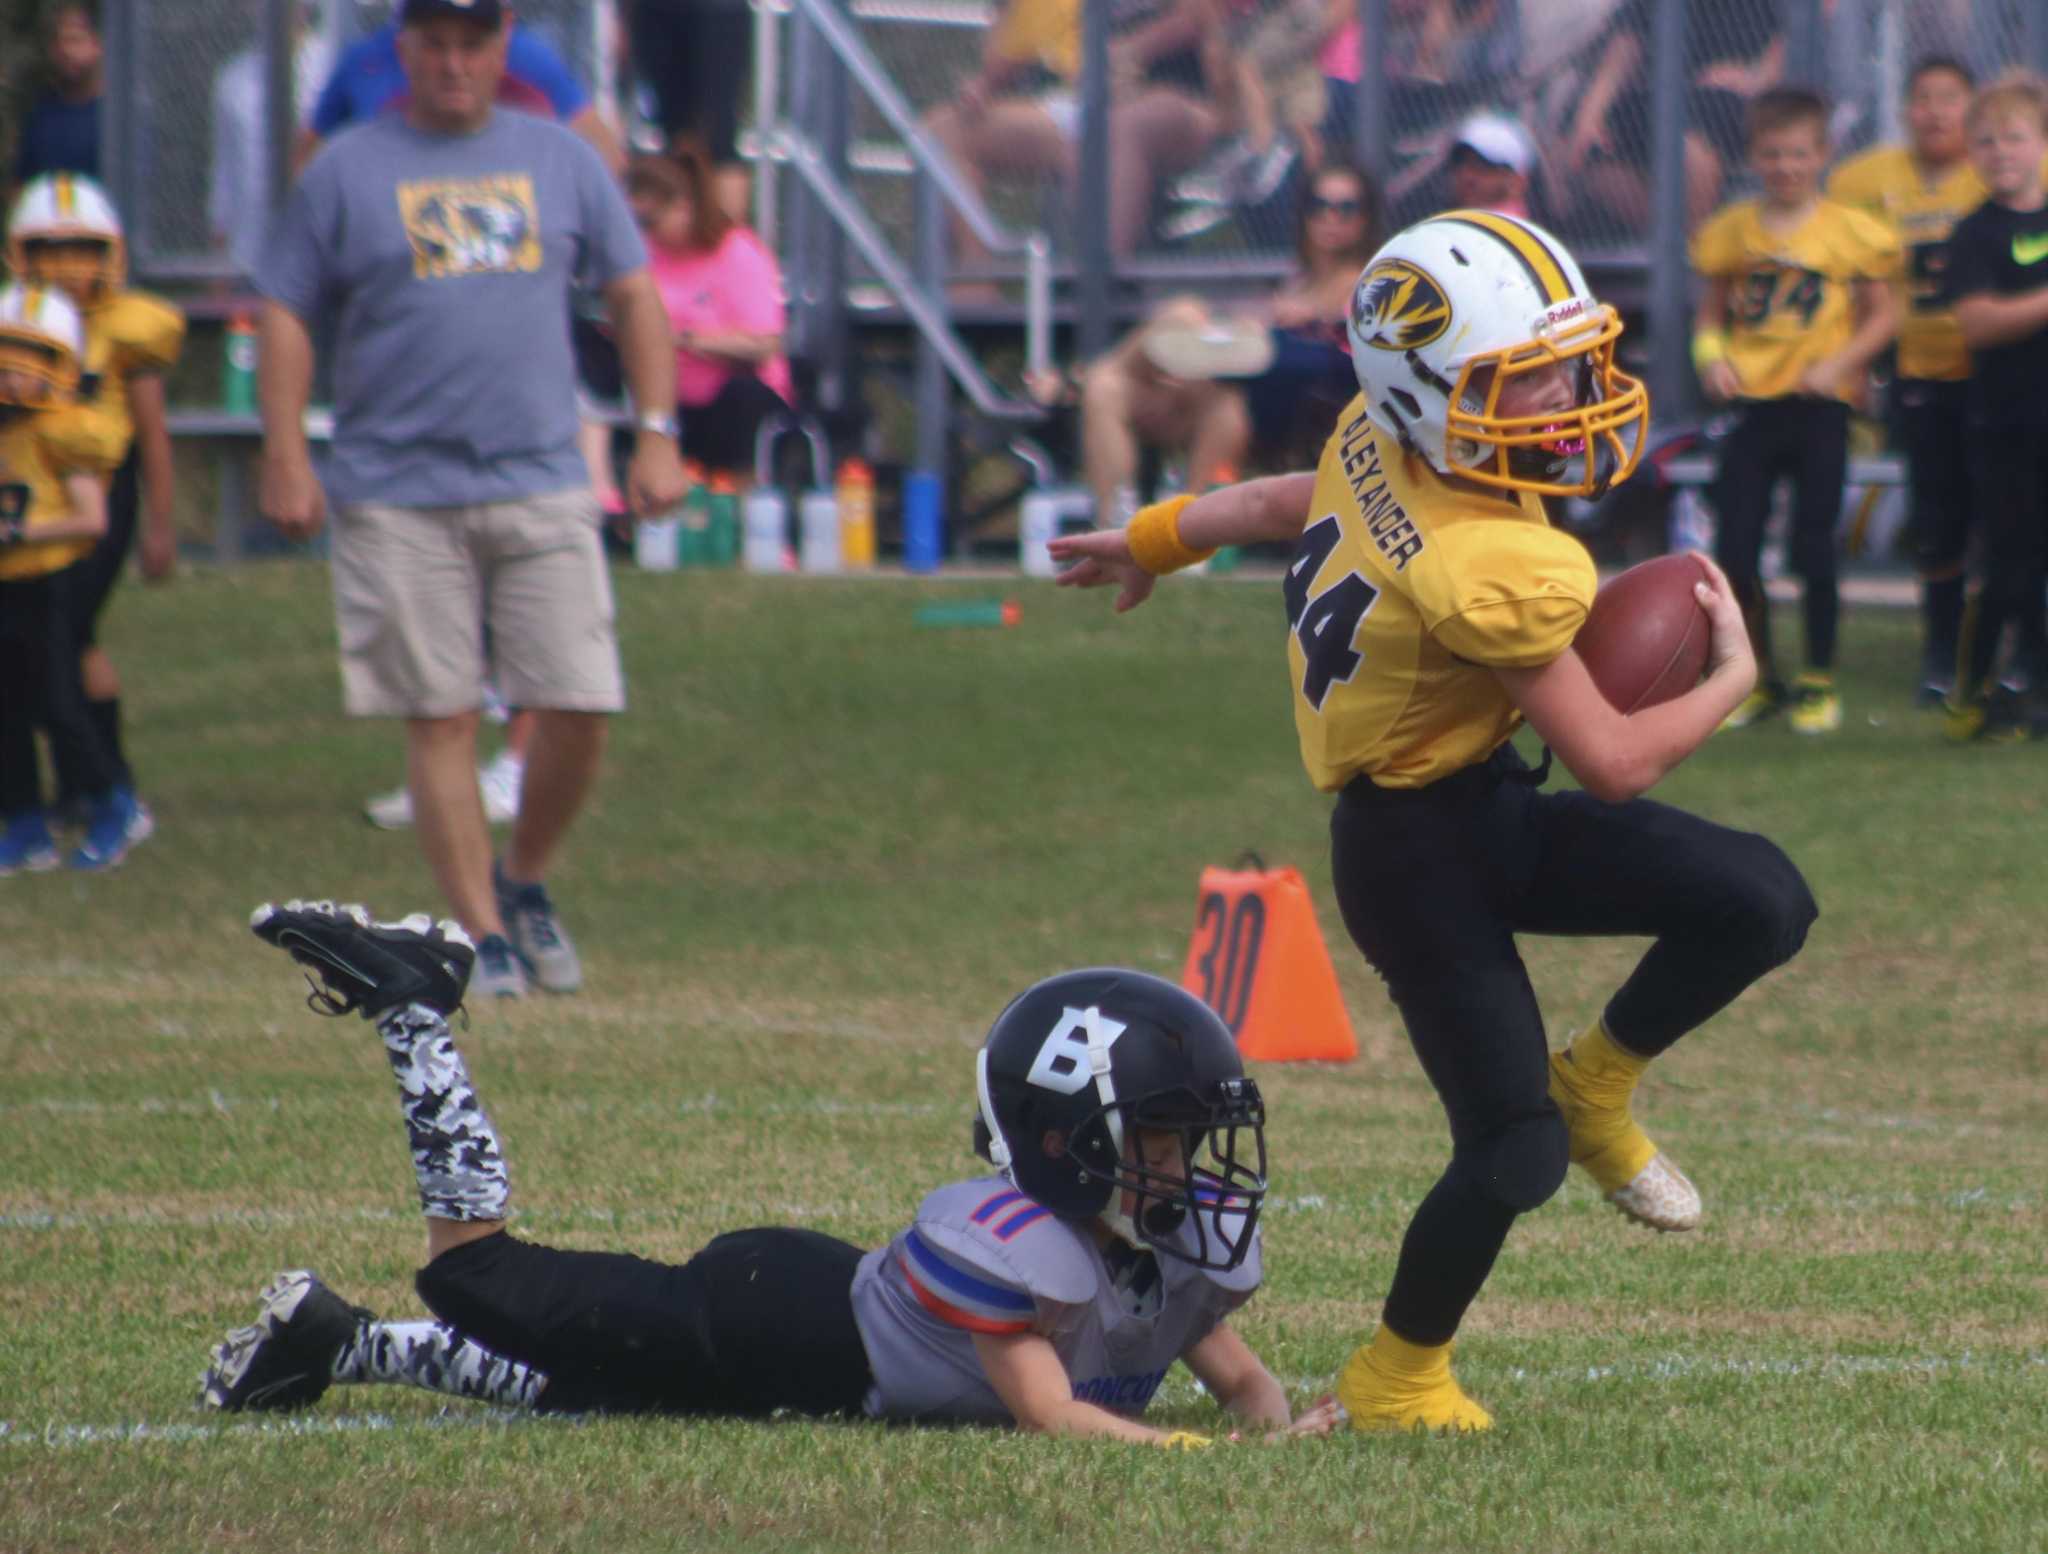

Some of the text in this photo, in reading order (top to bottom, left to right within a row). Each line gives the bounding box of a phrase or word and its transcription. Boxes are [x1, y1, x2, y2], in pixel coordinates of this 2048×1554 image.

[1547, 300, 1584, 325] Riddell
[1339, 411, 1424, 571] ALEXANDER
[1283, 514, 1380, 713] 44
[1199, 892, 1266, 1036] 30
[969, 1187, 1056, 1243] 11
